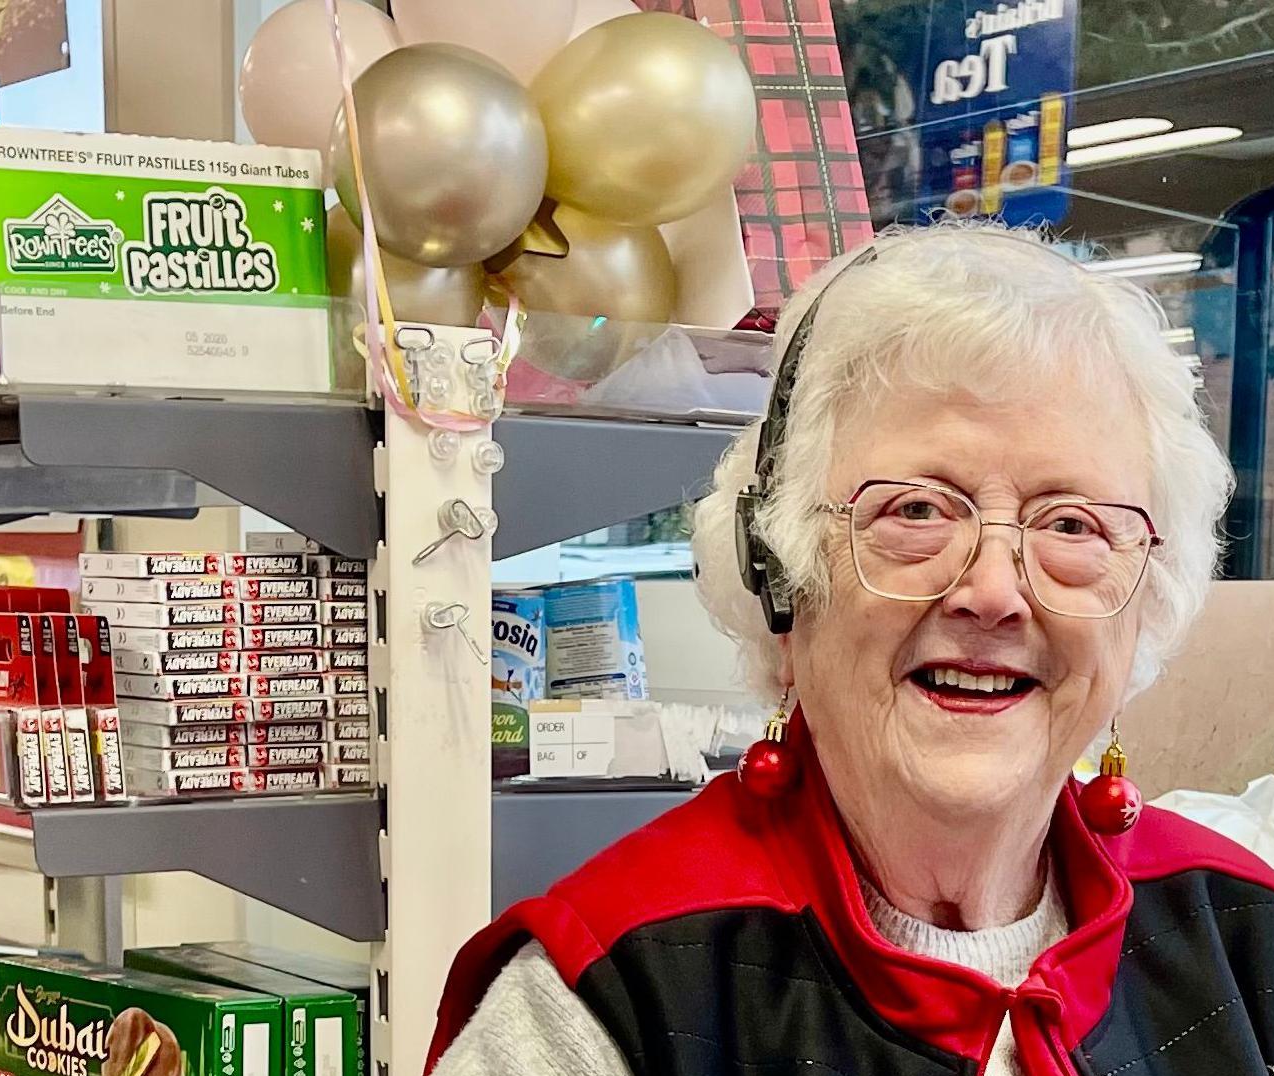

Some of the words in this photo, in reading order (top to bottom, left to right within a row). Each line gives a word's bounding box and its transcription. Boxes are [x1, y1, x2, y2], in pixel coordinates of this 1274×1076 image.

[97, 154, 134, 168] FRUIT
[138, 156, 205, 173] PASTILLES
[209, 161, 237, 178] 115g
[240, 163, 272, 178] Giant
[275, 166, 309, 180] Tubes
[1, 305, 33, 315] Before
[36, 307, 55, 316] End
[246, 556, 298, 570] EVEREADY
[260, 580, 309, 594] EVEREADY
[263, 605, 312, 619] EVEREADY
[264, 629, 313, 643] EVEREADY
[492, 620, 538, 656] osia
[260, 655, 312, 669] EVEREADY
[270, 679, 319, 693] EVEREADY
[274, 701, 323, 715] EVEREADY
[269, 724, 318, 738] EVEREADY
[537, 723, 565, 732] ORDER
[270, 748, 318, 762] EVEREADY
[537, 752, 555, 761] BAG
[577, 751, 587, 760] OF
[269, 772, 316, 785] EVEREADY
[7, 982, 110, 1060] Dubai
